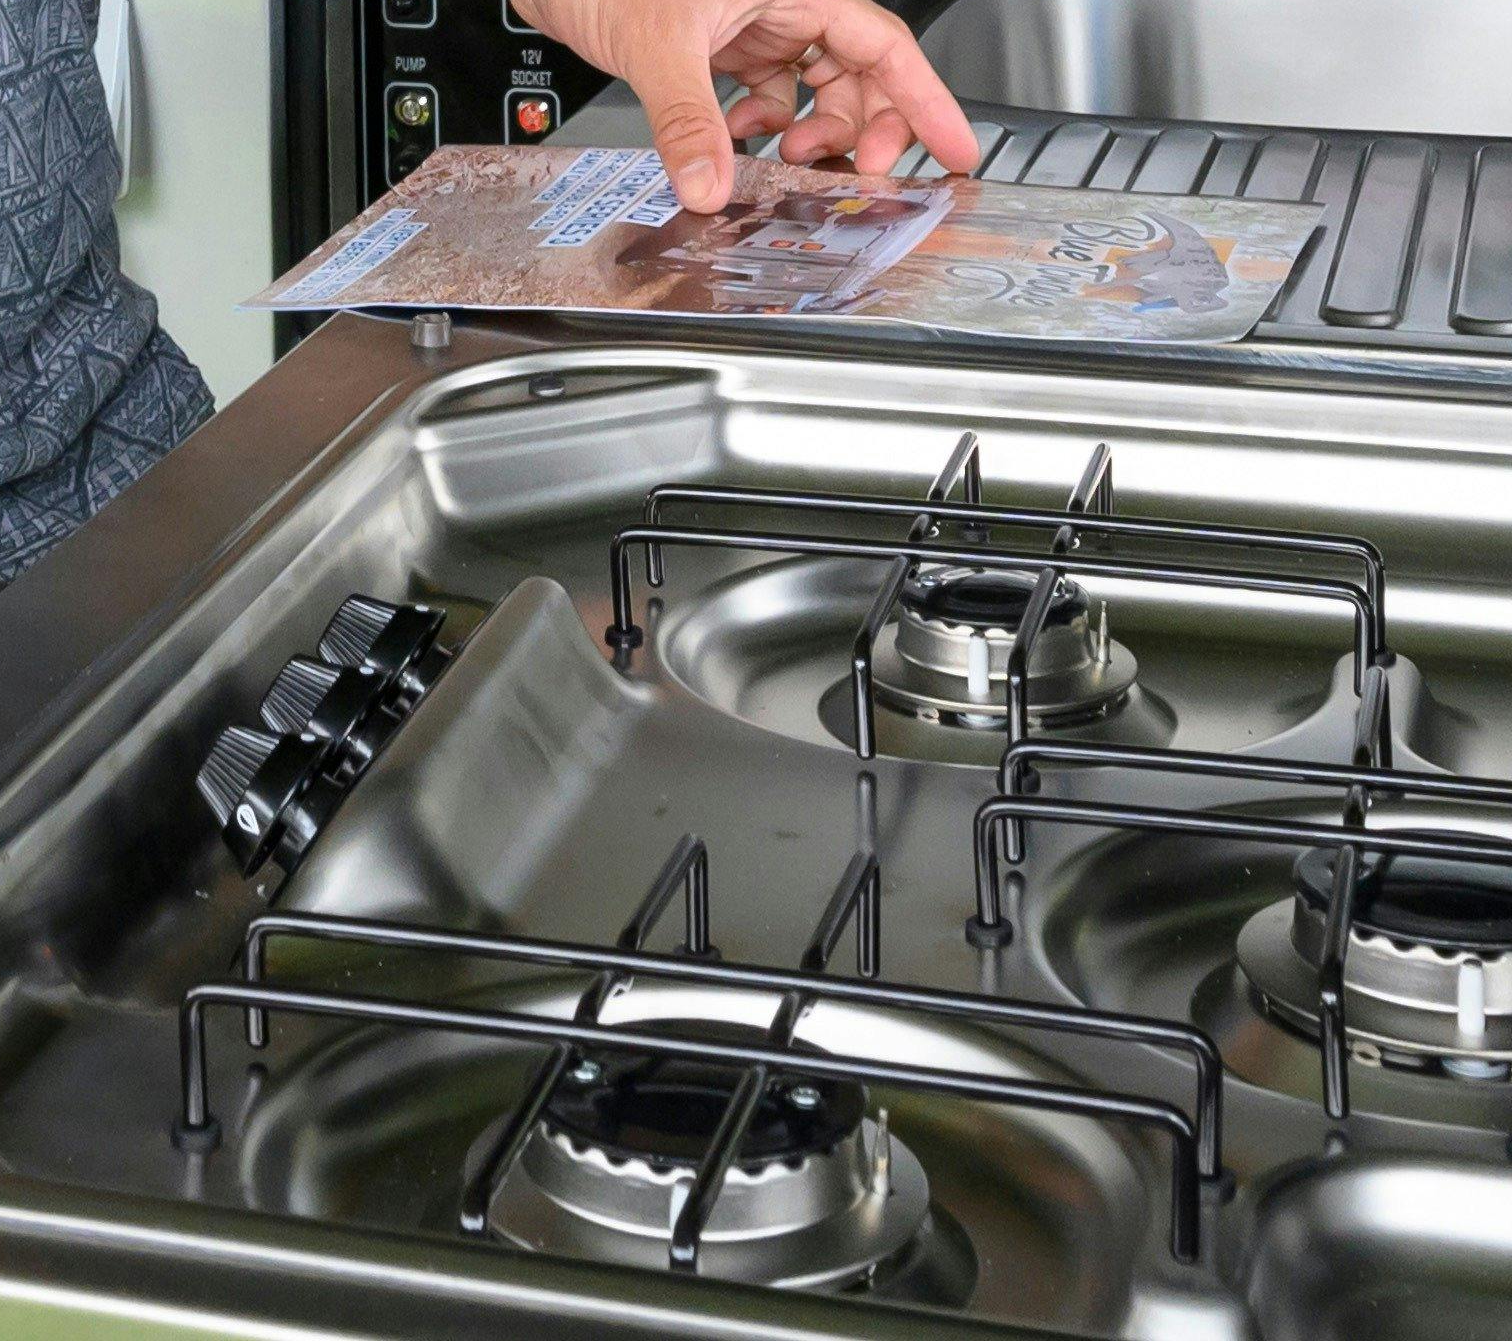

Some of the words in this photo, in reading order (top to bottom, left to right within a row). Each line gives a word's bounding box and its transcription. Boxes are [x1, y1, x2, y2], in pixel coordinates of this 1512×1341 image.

[394, 55, 427, 72] PUMP
[520, 48, 543, 66] 12V
[510, 69, 552, 87] SOCKET
[601, 152, 664, 199] XTREME
[1048, 216, 1157, 262] Blue
